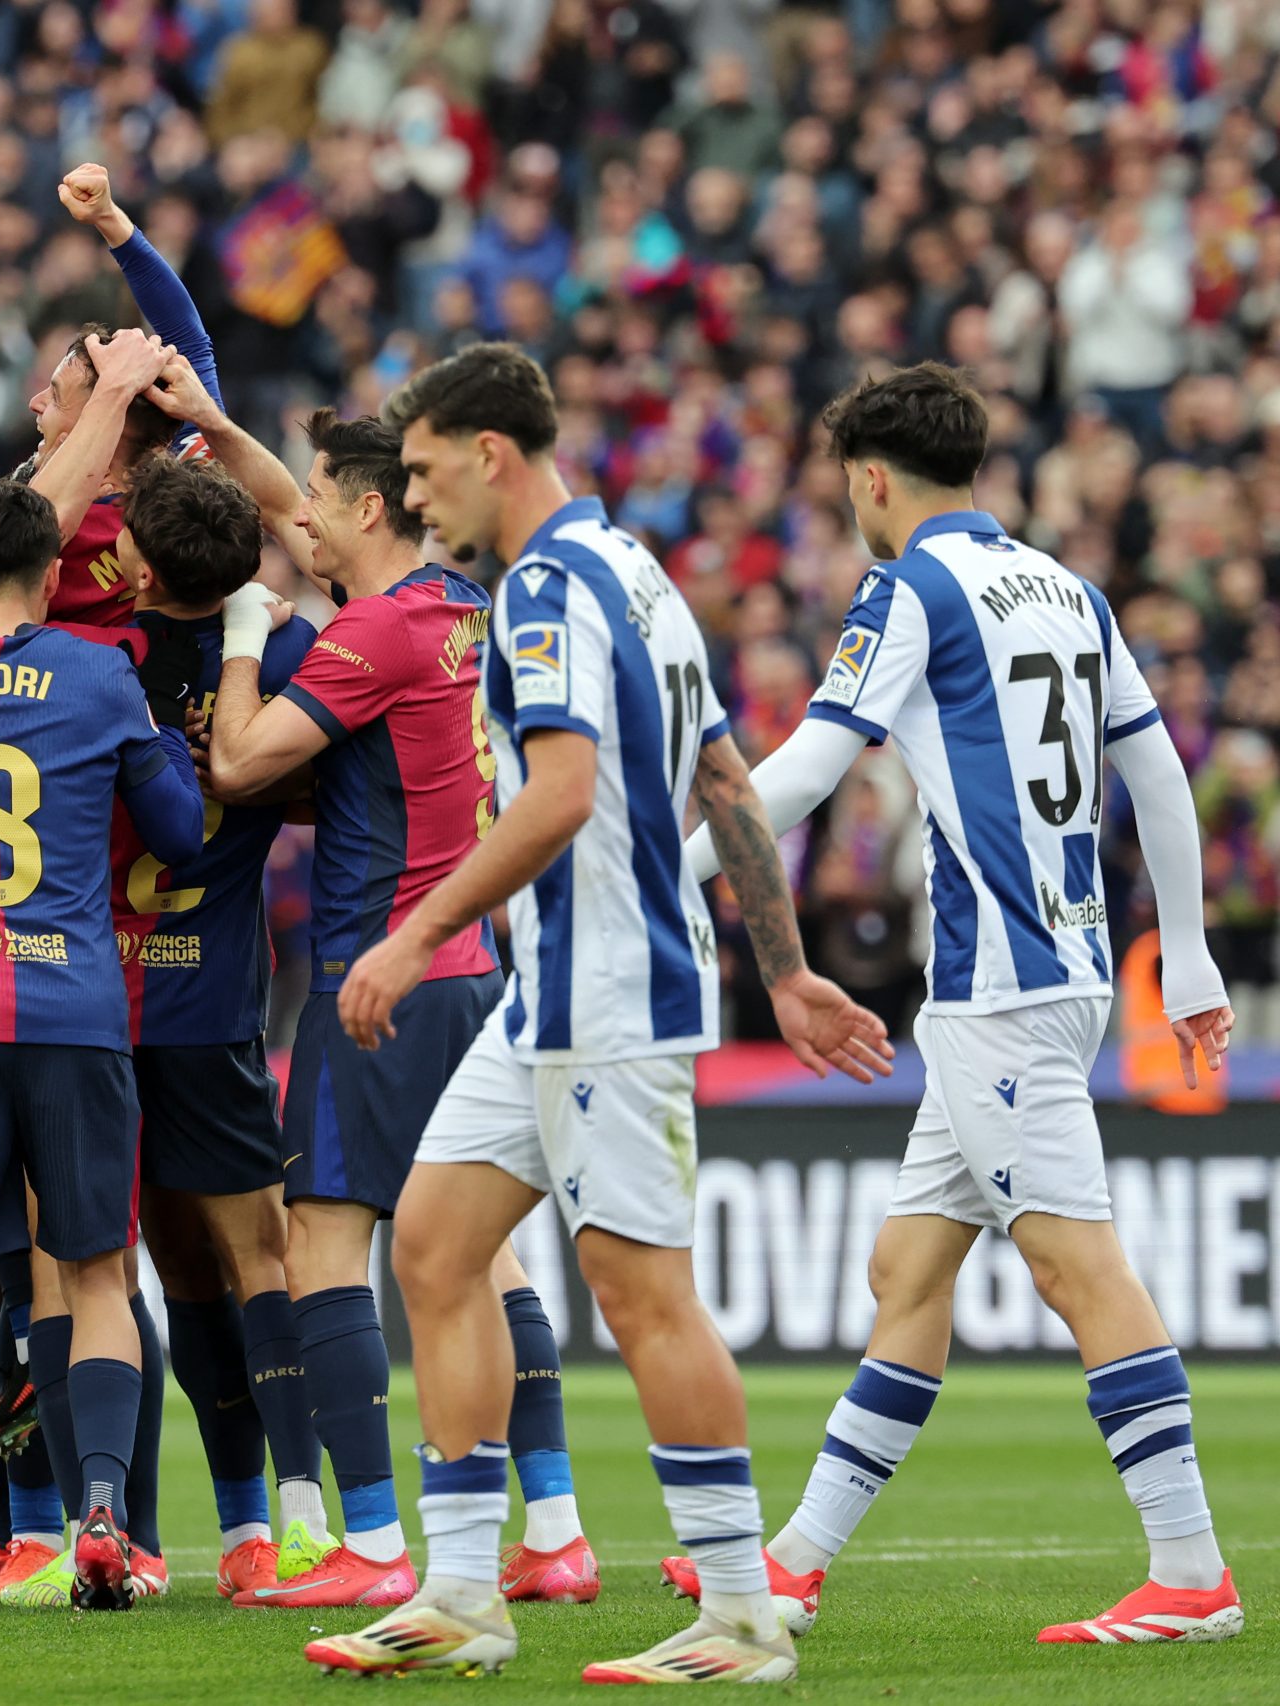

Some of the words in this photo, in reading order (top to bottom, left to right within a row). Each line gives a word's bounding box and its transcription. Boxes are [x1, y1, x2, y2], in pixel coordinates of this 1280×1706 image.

[979, 574, 1084, 623] MARTÍN
[363, 662, 375, 673] tv
[1008, 652, 1102, 827] 31
[5, 928, 65, 948] UNHCR
[143, 934, 201, 949] UNHCR
[5, 942, 68, 960] ACNUR
[138, 949, 201, 962] ACNUR
[849, 1475, 877, 1495] RS
